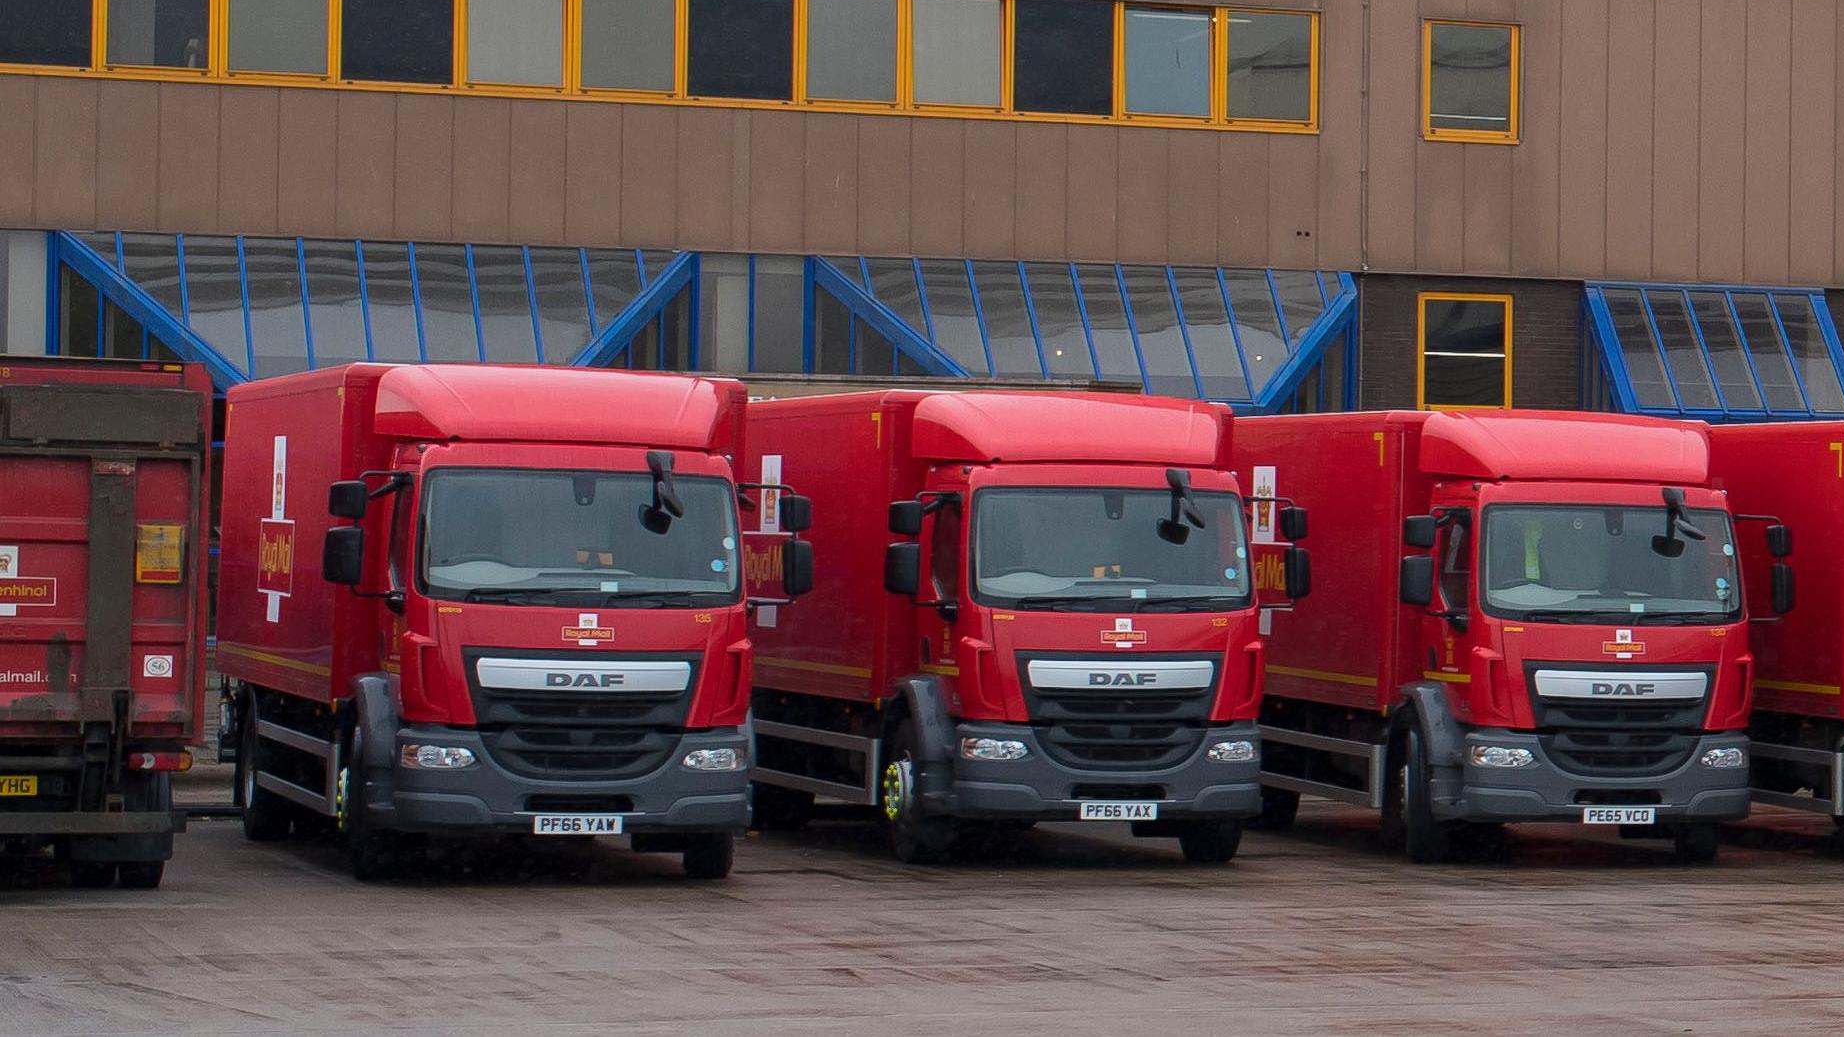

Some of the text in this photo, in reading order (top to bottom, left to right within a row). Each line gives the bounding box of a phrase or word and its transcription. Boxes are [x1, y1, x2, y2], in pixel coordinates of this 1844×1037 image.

[1266, 553, 1286, 591] Ma
[546, 673, 625, 688] DAF
[1089, 672, 1157, 686] DAF
[1592, 682, 1655, 696] DAF
[0, 778, 30, 793] YHG
[1086, 805, 1151, 818] PF66 YAX
[1588, 810, 1622, 822] PE65
[541, 817, 582, 832] PF66
